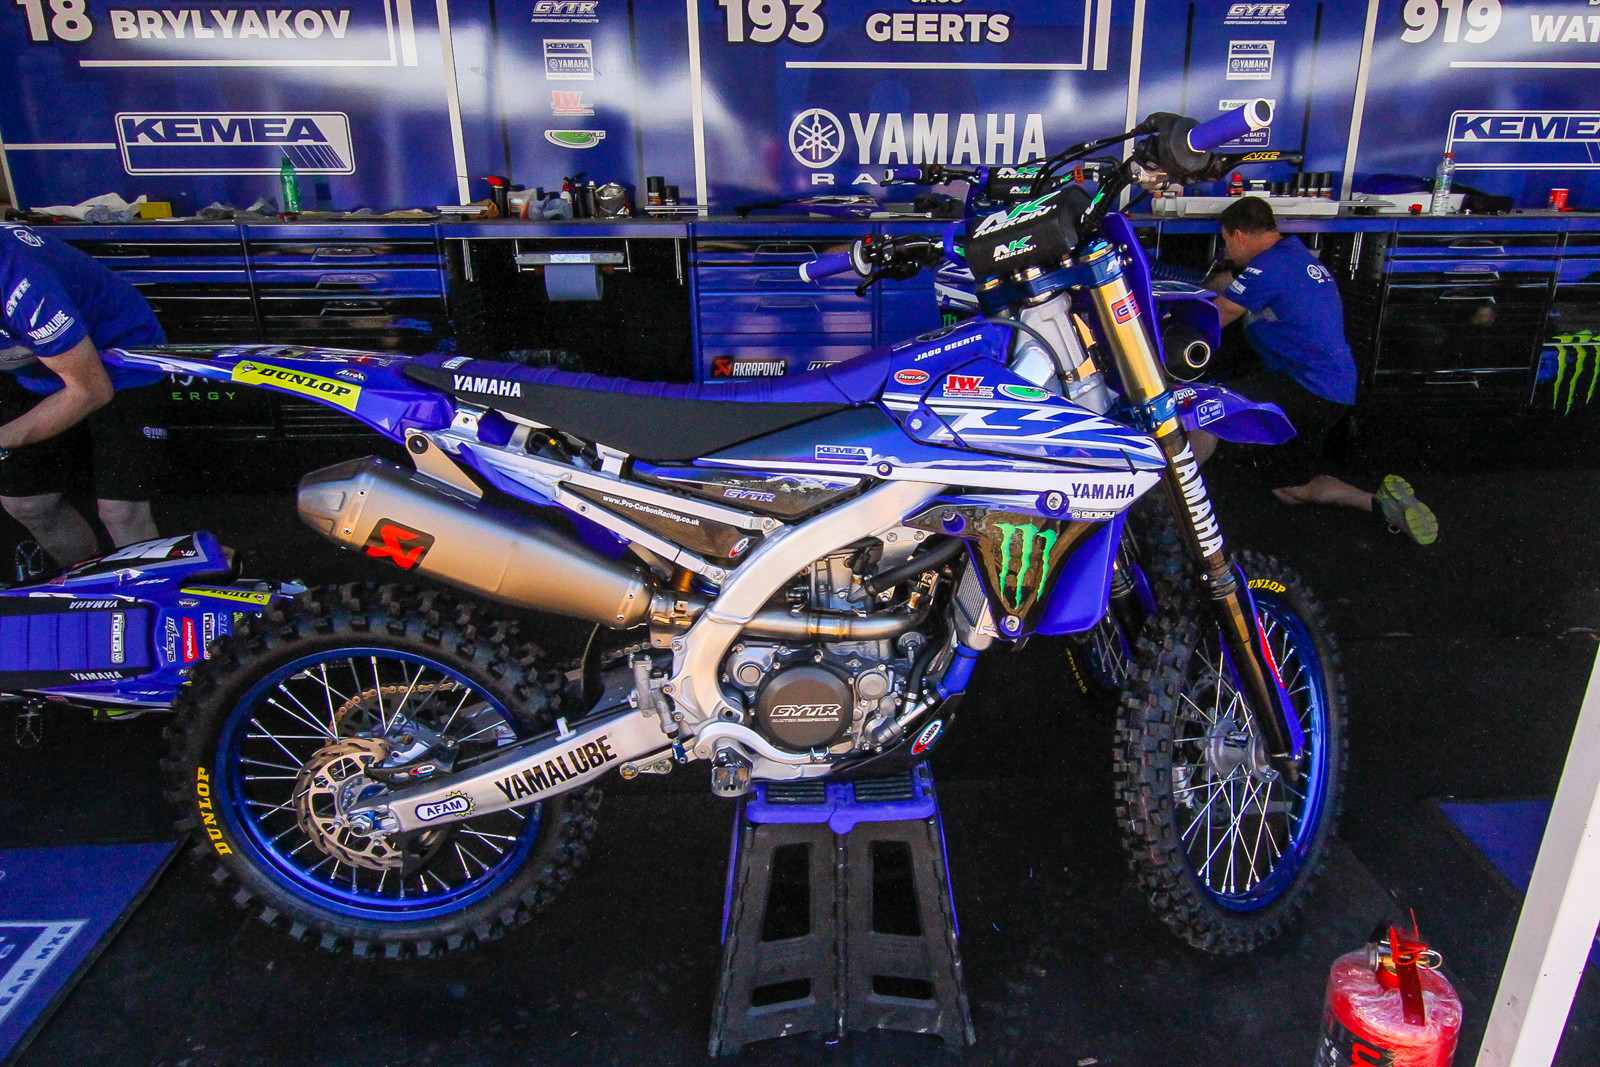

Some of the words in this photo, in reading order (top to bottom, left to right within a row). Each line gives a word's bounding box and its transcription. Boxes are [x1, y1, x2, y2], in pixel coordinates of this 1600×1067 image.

[533, 1, 598, 13] GYTR
[1227, 4, 1290, 15] GYTR
[17, 0, 93, 41] 18
[110, 10, 350, 39] BRYLYAKOV
[718, 0, 824, 43] 193
[866, 13, 1010, 42] GEERTS
[1400, 0, 1502, 43] 919
[558, 60, 588, 68] YAMAHA
[1240, 60, 1268, 68] YAMAHA
[122, 118, 329, 143] KEMEA
[849, 113, 1046, 165] YAMAHA
[1242, 152, 1280, 160] ARC
[6, 278, 31, 317] GYTR
[28, 310, 69, 340] YAMALUBE
[914, 347, 942, 362] JAGO
[944, 334, 982, 352] GEERTS
[336, 369, 365, 381] Airoh
[732, 361, 785, 376] AKRAPOVIČ
[257, 367, 351, 397] DUNLOP
[898, 373, 915, 381] Twin
[453, 374, 521, 398] YAMAHA
[172, 391, 235, 400] ERGY
[817, 446, 866, 455] KEMEA
[723, 488, 776, 502] GYTR
[1071, 483, 1135, 499] YAMAHA
[1172, 440, 1225, 558] YAMAHA
[602, 495, 700, 526] www.Pro-CarbonRacing.co.uk
[1247, 579, 1286, 593] UNLOP
[69, 600, 119, 609] YAMAHA
[70, 671, 123, 680] YAMAHA
[770, 704, 842, 717] GYTR
[494, 734, 618, 802] YAMALUBE
[197, 766, 233, 856] DUNLOP
[427, 800, 463, 816] AFAM
